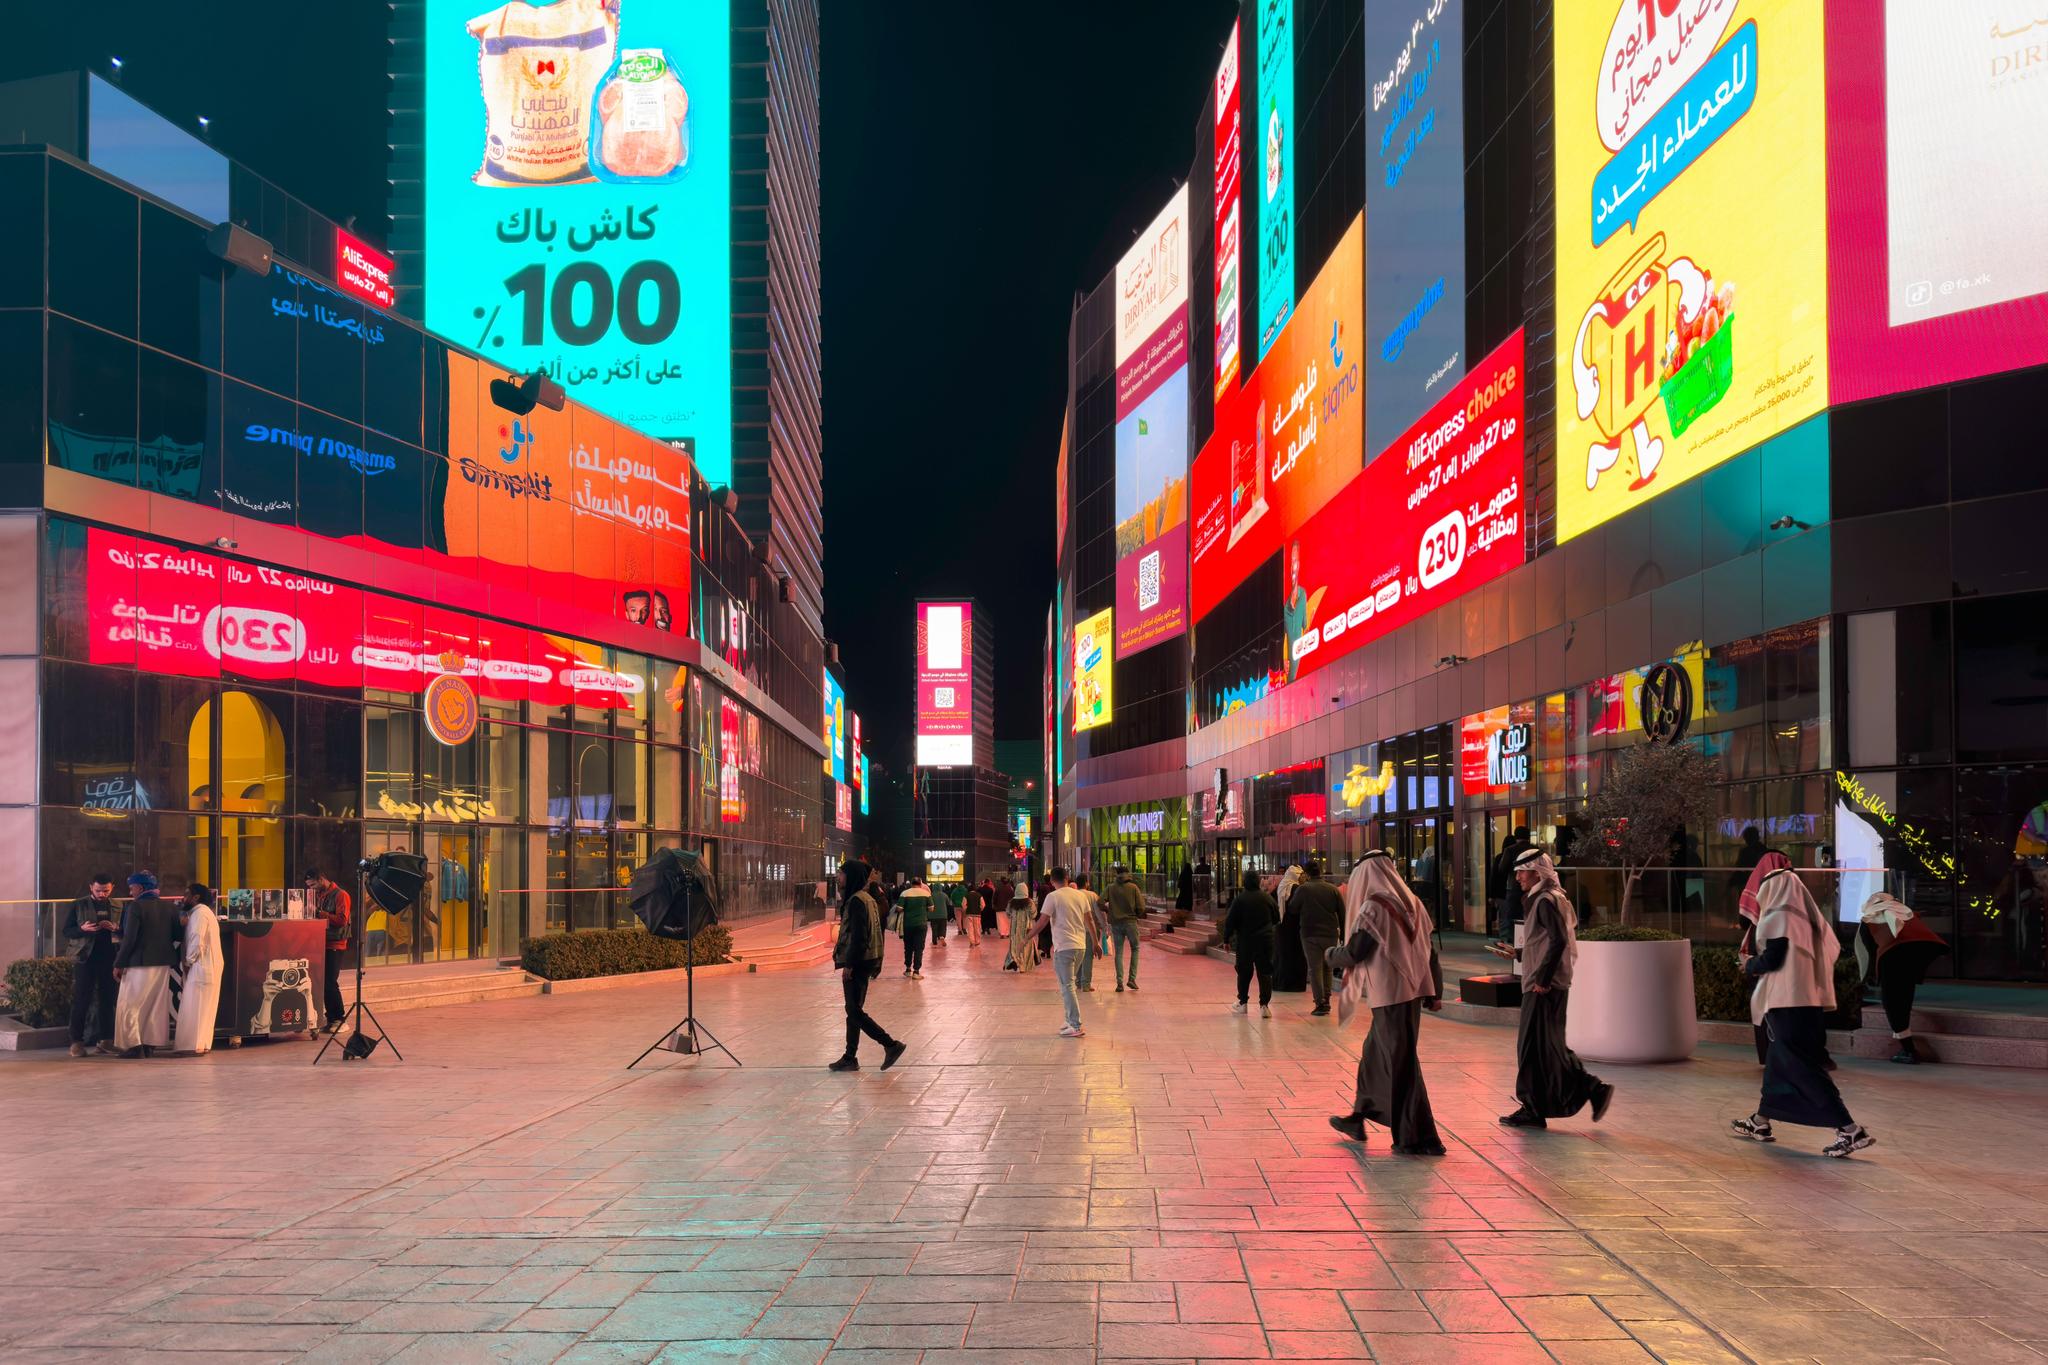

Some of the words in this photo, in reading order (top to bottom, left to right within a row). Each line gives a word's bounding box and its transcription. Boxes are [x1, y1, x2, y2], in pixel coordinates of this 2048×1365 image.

[1663, 43, 1747, 164] للعملاء
[510, 131, 535, 143] Punjabi
[1597, 134, 1657, 224] الجدد
[496, 207, 557, 252] باك
[568, 205, 658, 251] كاش
[567, 366, 598, 386] من
[603, 354, 641, 385] أكثر
[646, 359, 682, 385] على
[1273, 360, 1317, 435] فلوسك
[1323, 363, 1358, 424] tiqmo
[1406, 409, 1465, 475] AliExpress
[1466, 366, 1516, 423] choice
[1485, 421, 1499, 447] 27
[1501, 417, 1516, 440] من
[1461, 434, 1485, 473] فبراير
[1428, 468, 1441, 493] 27
[1442, 459, 1457, 484] إلى
[1407, 482, 1428, 510] مارس
[1467, 477, 1518, 527] خصومات
[1477, 513, 1518, 552] رمضانية
[1426, 524, 1459, 575] 230
[1405, 574, 1418, 597] ريال
[1502, 754, 1527, 784] NOUG
[1118, 811, 1164, 834] MACHINIST
[924, 850, 965, 859] DUNKIN'
